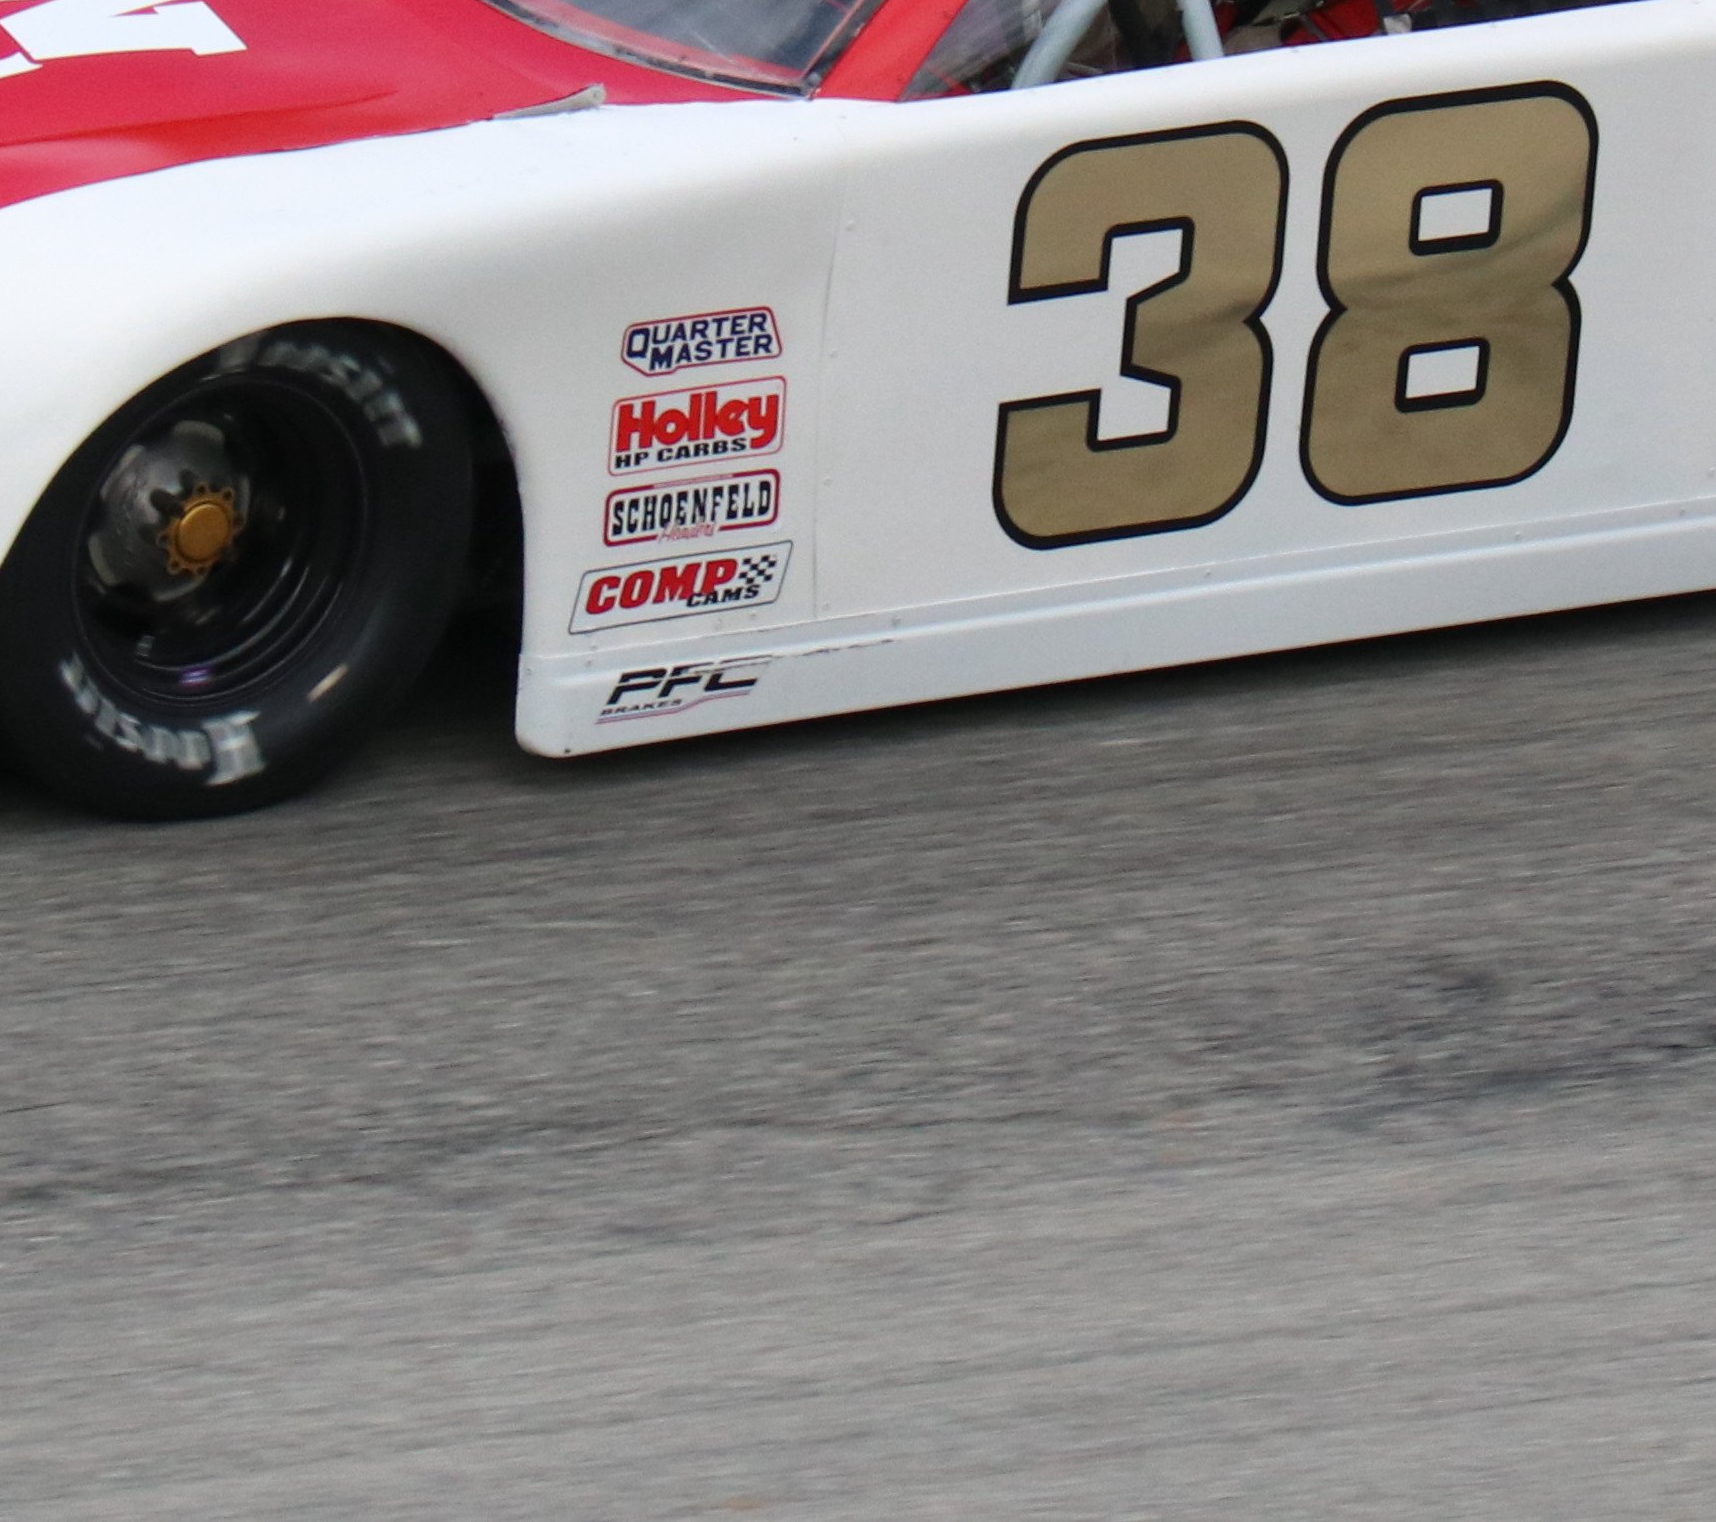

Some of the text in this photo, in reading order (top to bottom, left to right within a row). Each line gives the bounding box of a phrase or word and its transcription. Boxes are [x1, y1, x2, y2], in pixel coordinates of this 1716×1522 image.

[626, 312, 767, 358] QUARTER
[992, 80, 1599, 550] 38
[649, 334, 773, 370] MASTER
[615, 390, 779, 452] Holley
[615, 437, 747, 469] HP CARBS
[612, 481, 771, 536] SCHOENFELD
[586, 558, 738, 614] COMP
[686, 583, 761, 607] CAMS
[607, 655, 772, 705] PFC
